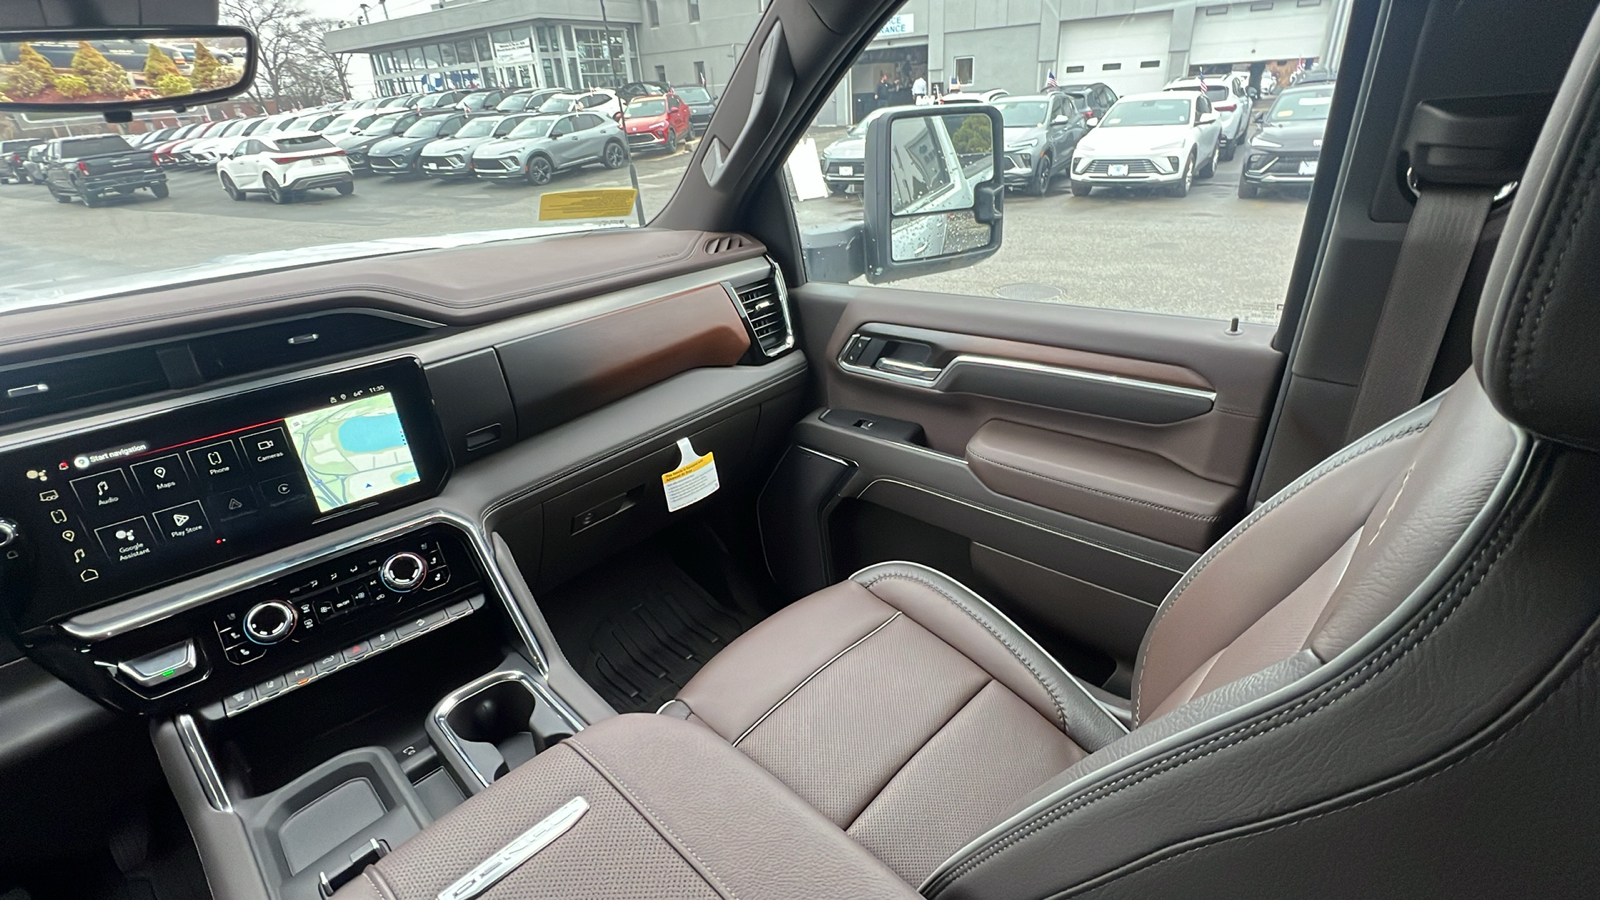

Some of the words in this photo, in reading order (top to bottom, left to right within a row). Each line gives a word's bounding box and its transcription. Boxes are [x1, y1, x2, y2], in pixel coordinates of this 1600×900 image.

[369, 384, 385, 393] 11:30
[89, 453, 109, 463] Start
[109, 444, 147, 456] navigation
[257, 452, 284, 462] Cameras
[209, 466, 230, 475] Phone
[156, 481, 176, 490] Maps
[98, 496, 119, 506] Audio
[171, 530, 185, 538] Play
[185, 525, 203, 534] Store
[119, 542, 144, 553] Google
[119, 548, 151, 561] Assistant
